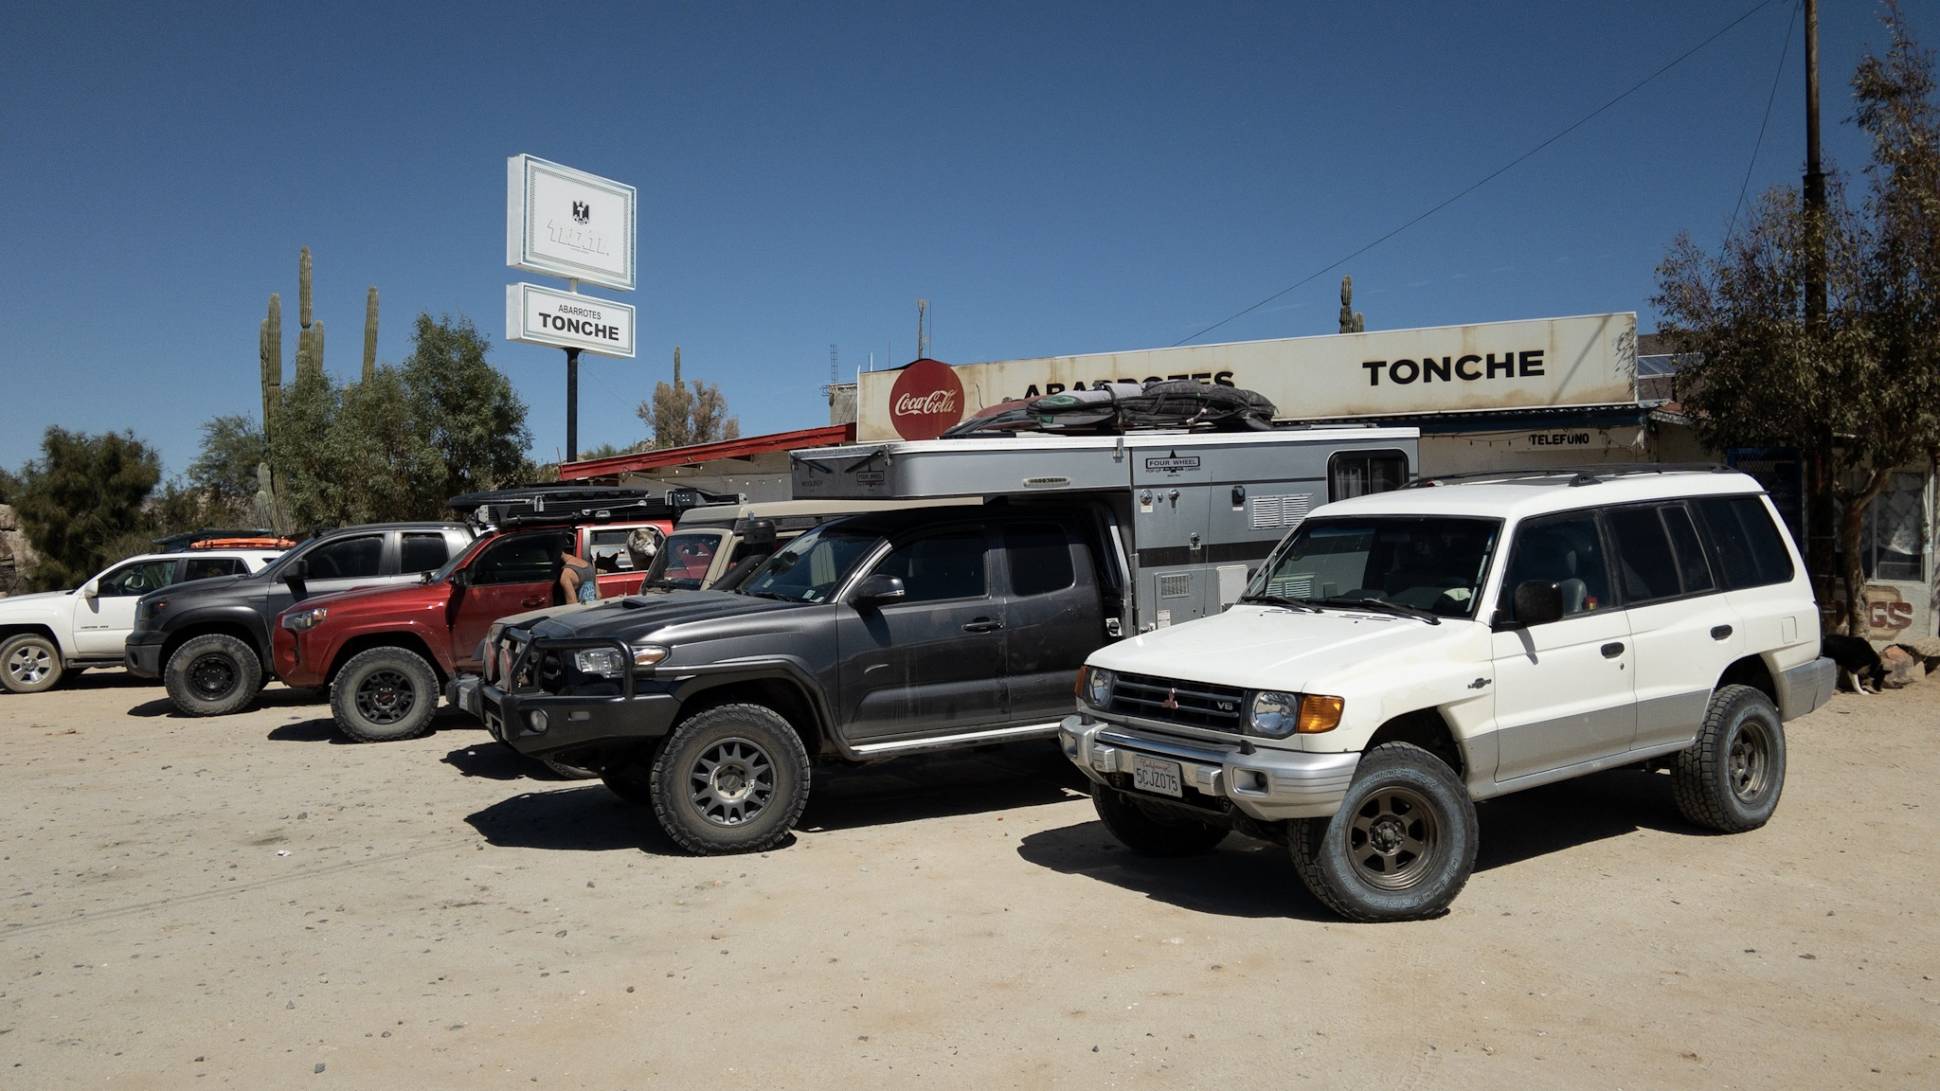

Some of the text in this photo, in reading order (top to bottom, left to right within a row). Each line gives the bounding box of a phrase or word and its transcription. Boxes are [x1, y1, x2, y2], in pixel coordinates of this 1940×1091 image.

[559, 304, 601, 319] ABARROTES
[539, 312, 619, 340] TONCHE
[1362, 350, 1544, 386] TONCHE
[1217, 702, 1233, 710] V6
[1136, 768, 1178, 791] 5CJZ075
